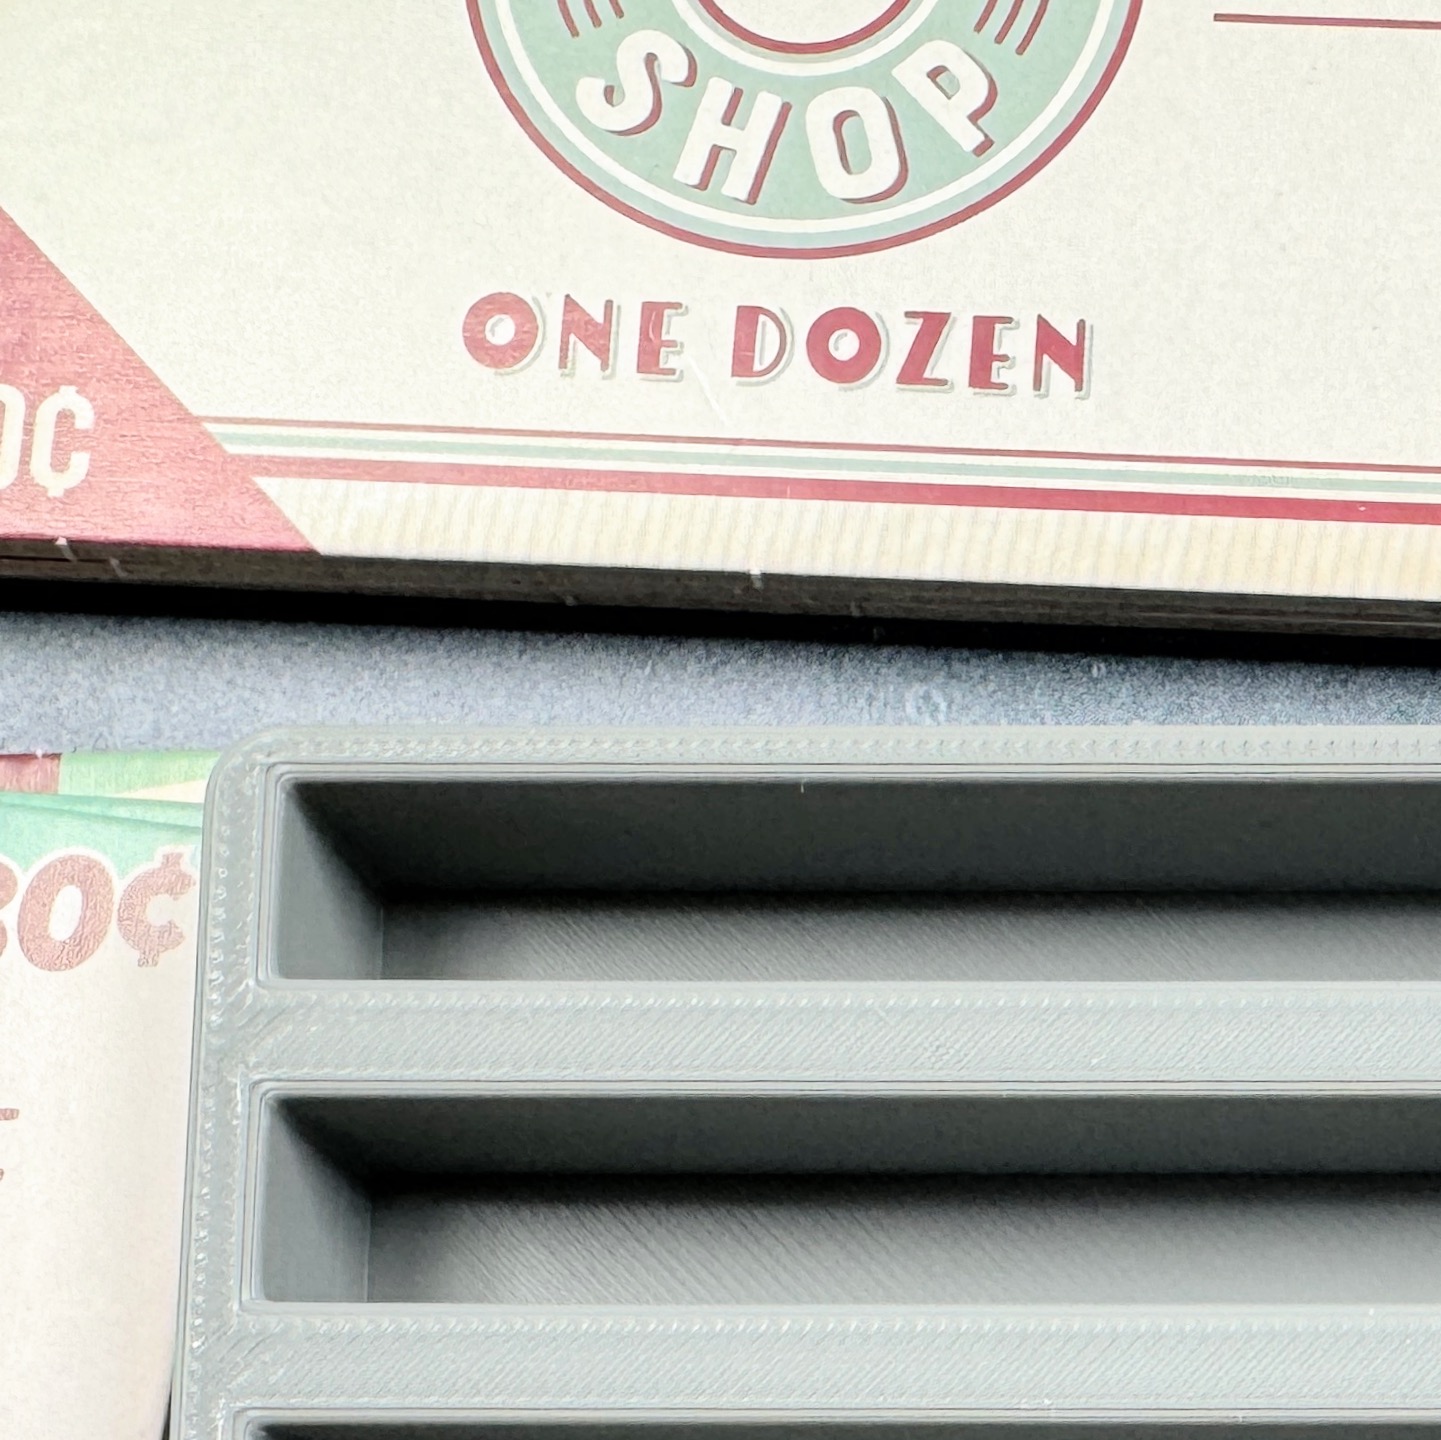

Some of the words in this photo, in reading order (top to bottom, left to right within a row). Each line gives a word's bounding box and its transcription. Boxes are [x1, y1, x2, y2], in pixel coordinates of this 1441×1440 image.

[575, 28, 1000, 205] SHOP
[462, 291, 686, 382] ONE
[730, 304, 1093, 399] DOZEN
[0, 852, 196, 972] 0¢
